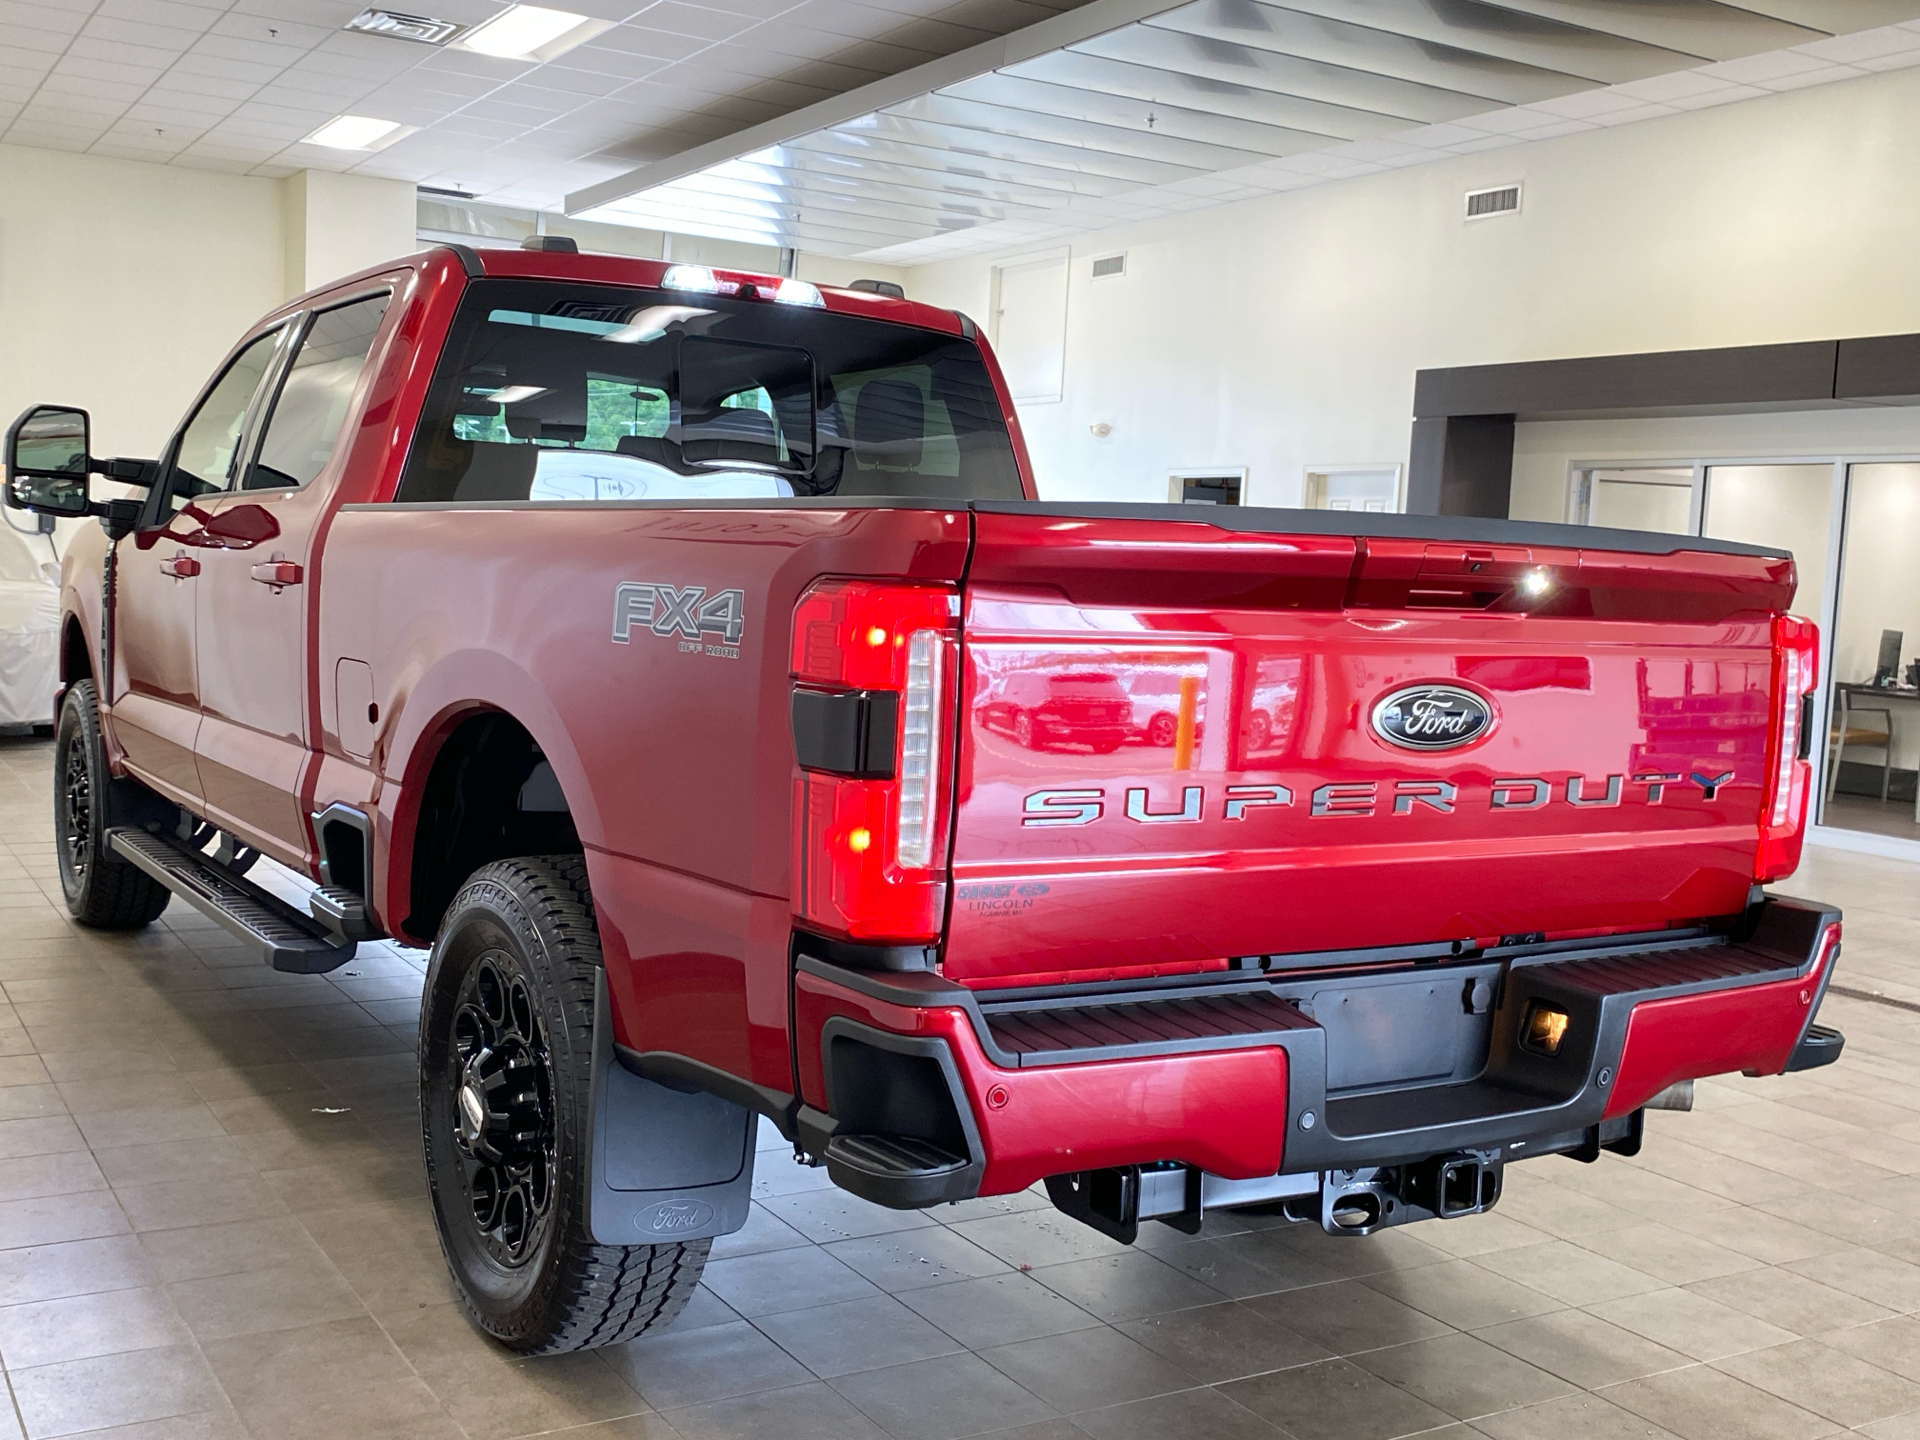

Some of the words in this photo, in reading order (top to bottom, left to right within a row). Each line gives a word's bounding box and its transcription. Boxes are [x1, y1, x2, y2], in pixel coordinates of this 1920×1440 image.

[611, 581, 744, 645] FX4
[678, 641, 702, 653] OFF
[705, 645, 740, 659] ROAD
[1021, 780, 1458, 828] SUPER
[1490, 770, 1736, 813] DUTY
[969, 899, 1033, 910] LINCOLN
[652, 1205, 698, 1230] Ford
